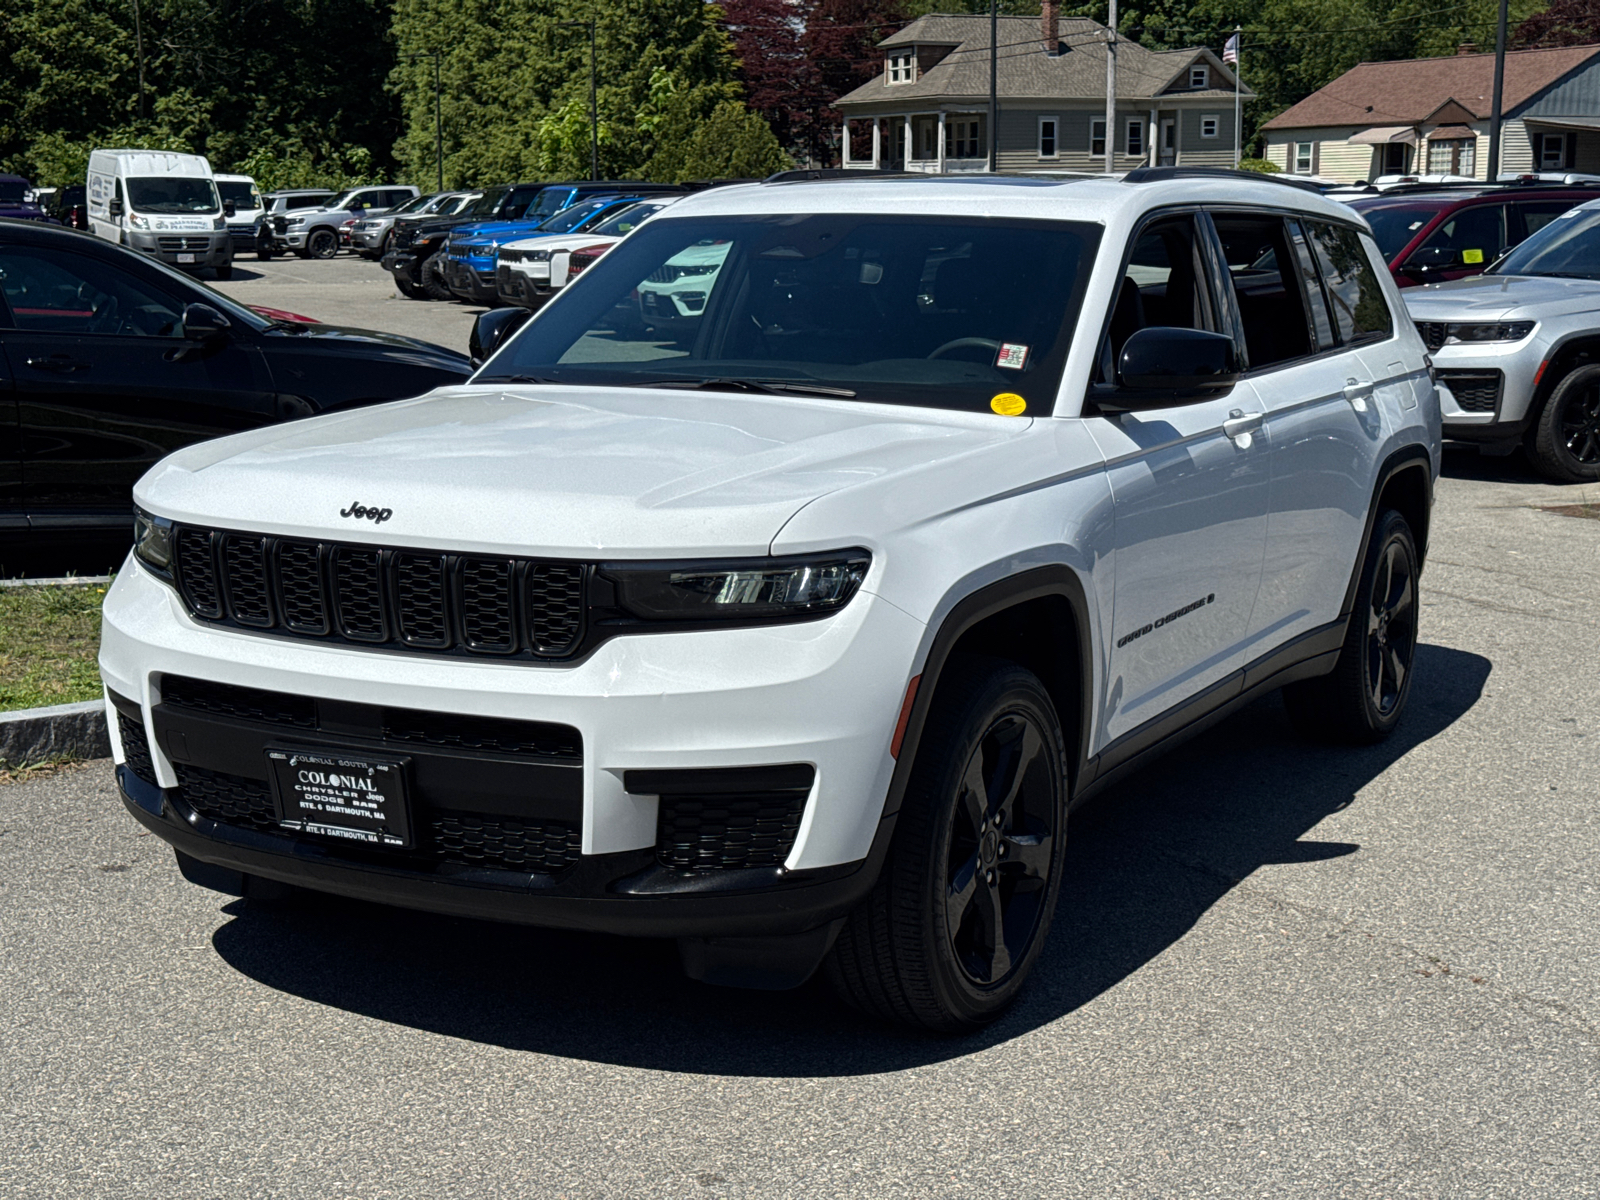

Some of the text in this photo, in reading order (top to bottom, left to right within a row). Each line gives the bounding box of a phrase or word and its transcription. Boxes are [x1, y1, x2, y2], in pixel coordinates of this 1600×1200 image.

[340, 501, 393, 525] Jeep
[1117, 623, 1153, 649] GRAND
[1154, 597, 1206, 629] CHEROKEE
[294, 755, 335, 766] COLONIAL
[338, 760, 368, 769] SOUTH
[298, 770, 377, 792] COLONIAL
[294, 785, 385, 803] CHRYSLER Jeep
[304, 793, 378, 809] DODGE RAM
[299, 801, 386, 820] RTE. 6 DARTMOUTH, MA
[306, 825, 320, 834] RTE.
[327, 829, 368, 842] DARTMOUTH,
[368, 834, 379, 843] MA
